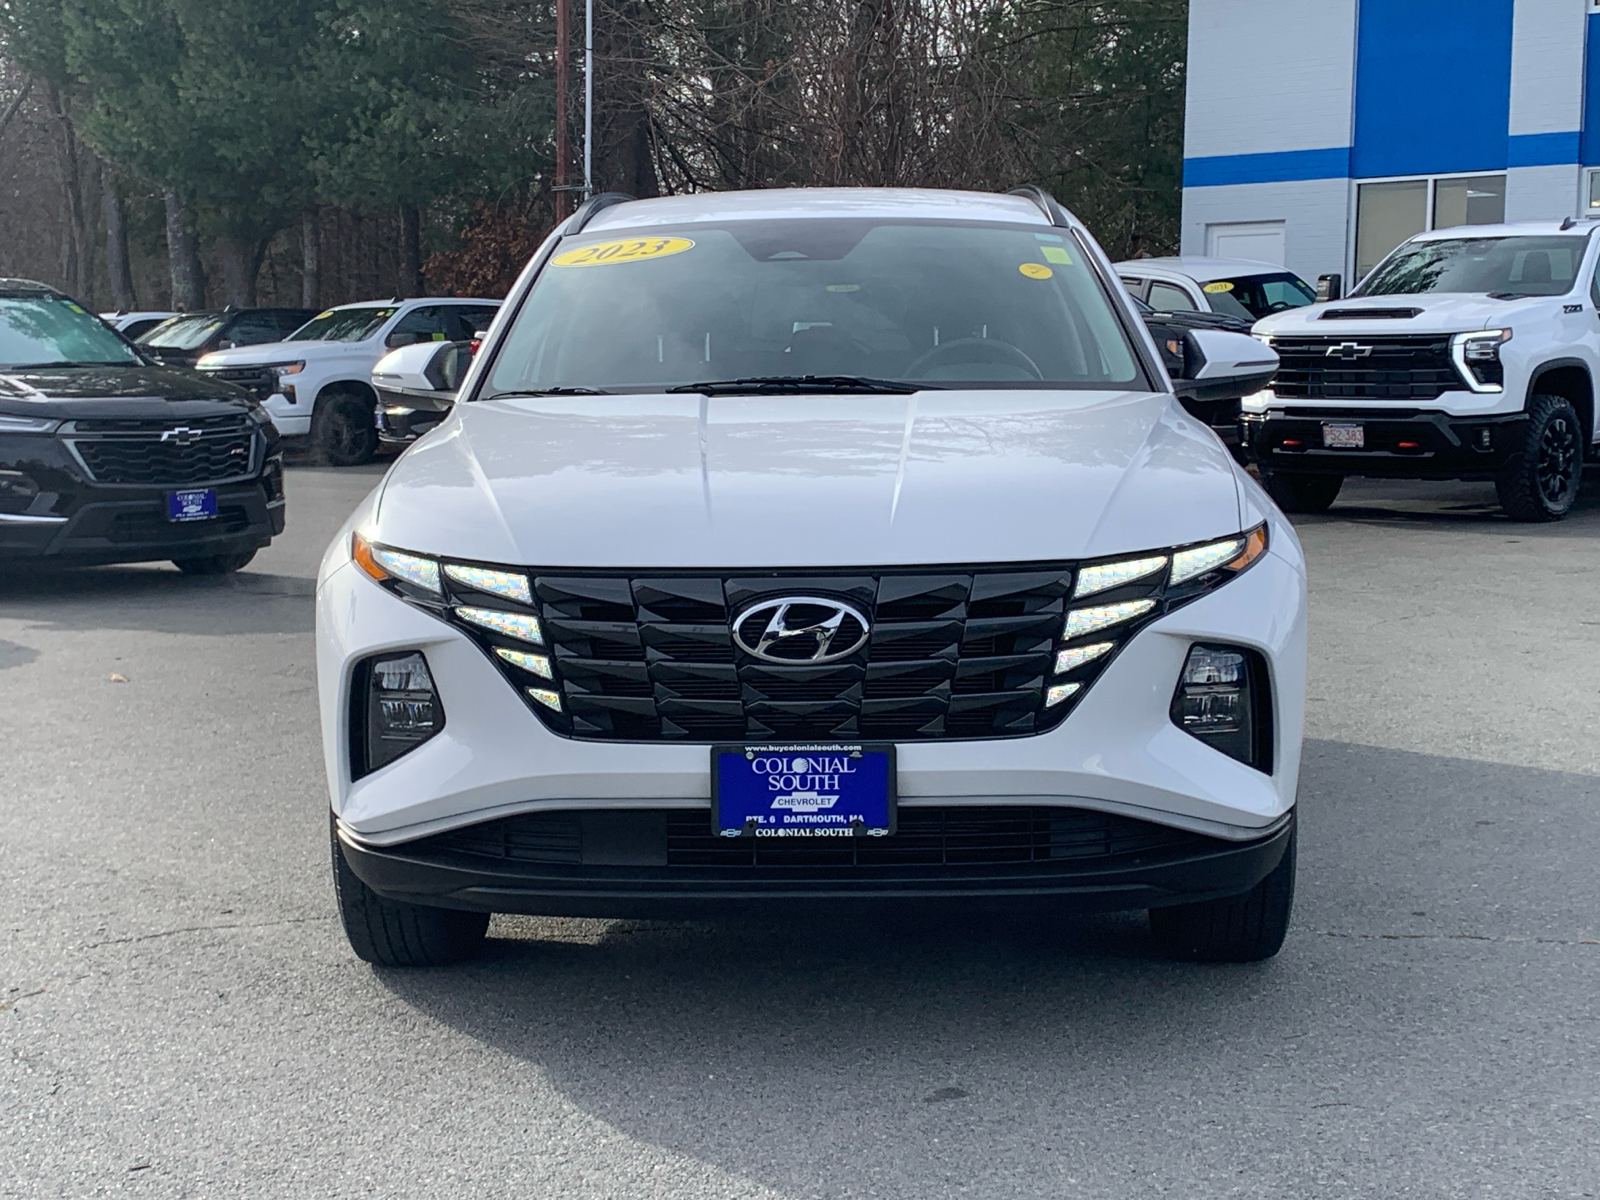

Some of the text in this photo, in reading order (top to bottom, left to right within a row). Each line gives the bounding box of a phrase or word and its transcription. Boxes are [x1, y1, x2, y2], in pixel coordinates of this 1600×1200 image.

[570, 238, 671, 264] 2023
[1210, 283, 1228, 292] 2021
[1344, 429, 1363, 441] 383
[744, 744, 862, 752] www.buycolonialsouth.com
[752, 757, 857, 774] COLONIAL
[768, 774, 840, 791] SOUTH
[777, 797, 832, 806] CHEVROLET
[769, 815, 776, 823] 6
[783, 815, 847, 824] DARTMOUTH,
[849, 814, 865, 823] MA
[755, 828, 854, 837] COLONIAL SOUTH
